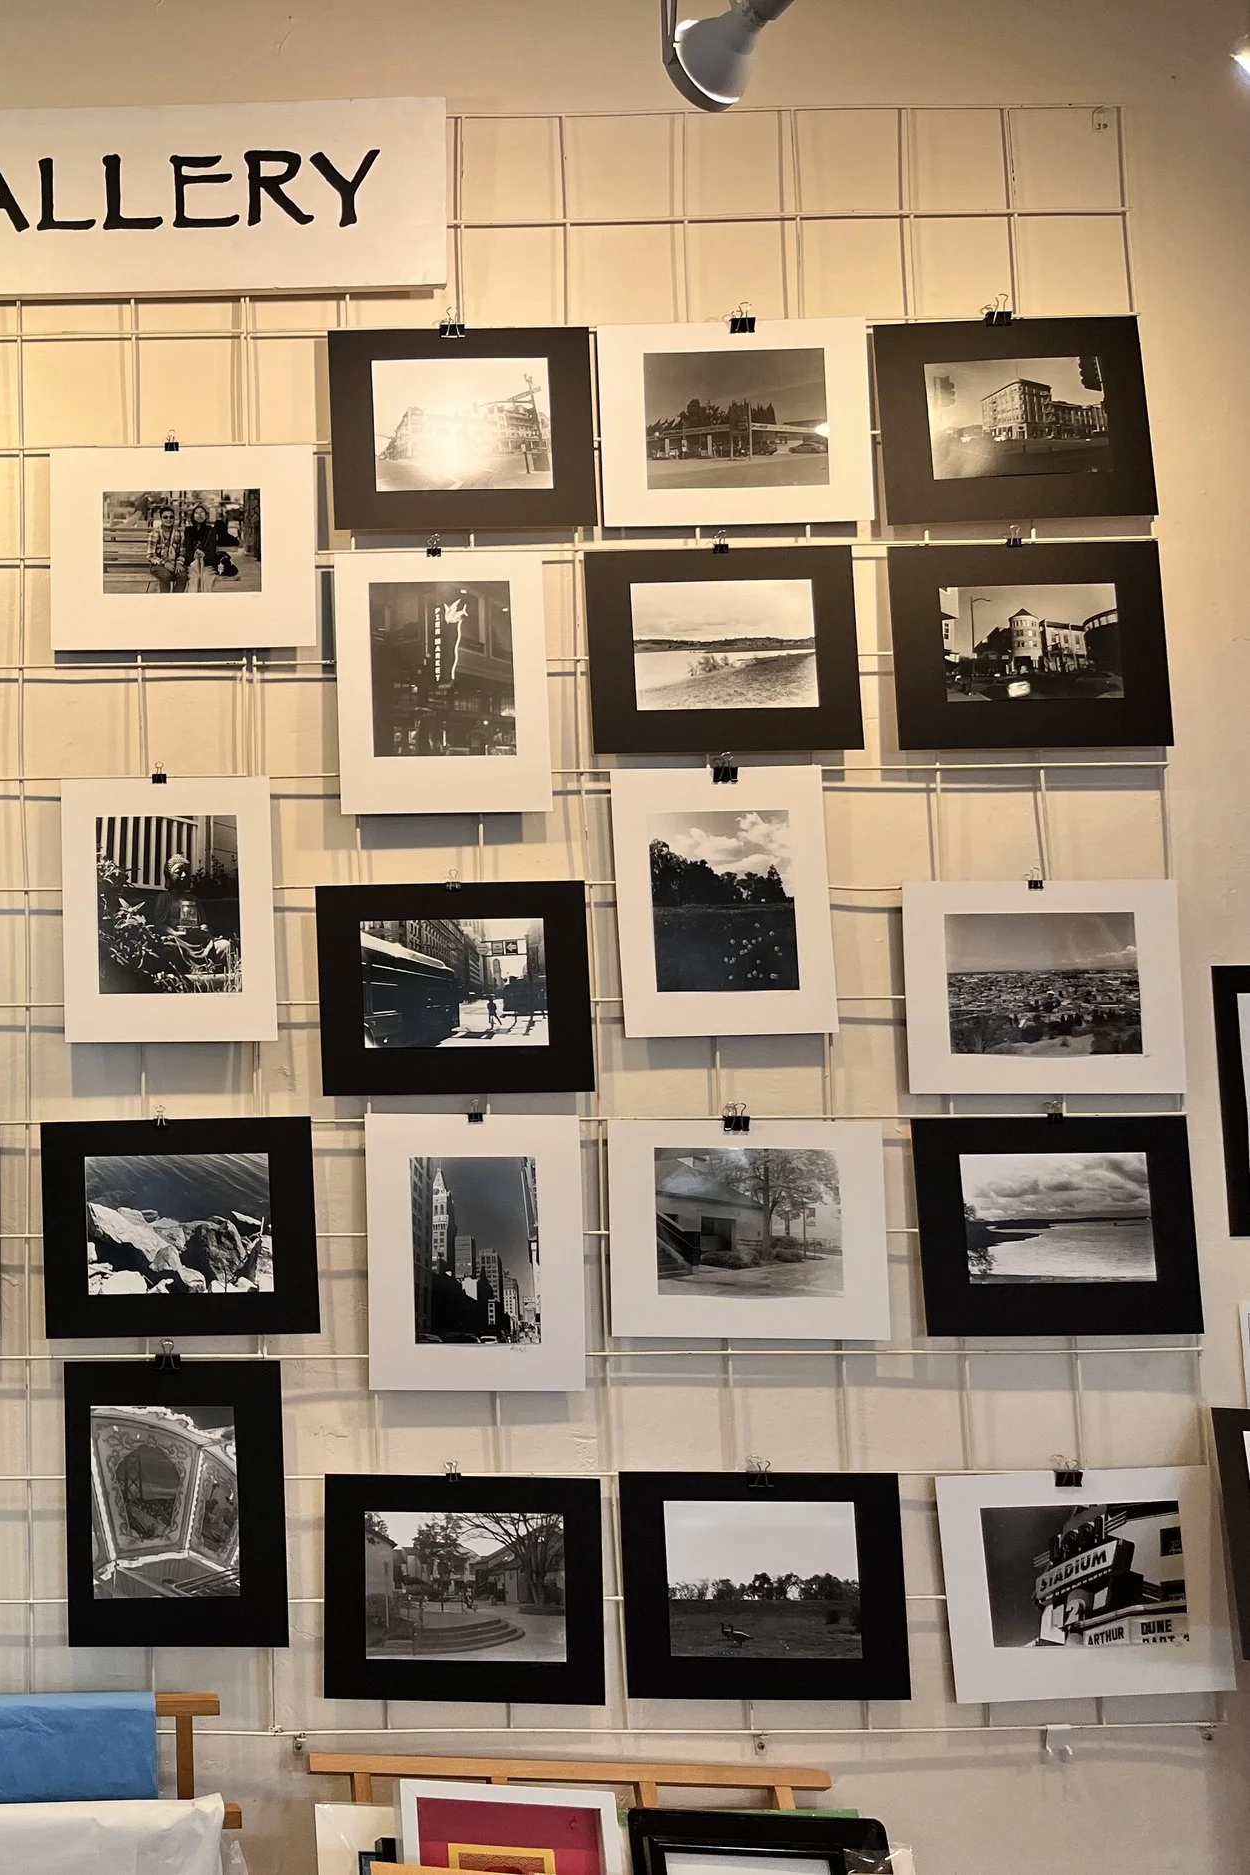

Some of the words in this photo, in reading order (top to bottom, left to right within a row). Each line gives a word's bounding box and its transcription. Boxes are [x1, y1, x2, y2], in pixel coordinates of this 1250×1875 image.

[434, 607, 442, 636] PIER
[434, 638, 442, 682] MARKET
[1039, 1549, 1108, 1592] STADIUM
[1087, 1626, 1125, 1646] ARTHUR
[1140, 1619, 1173, 1635] DUNE
